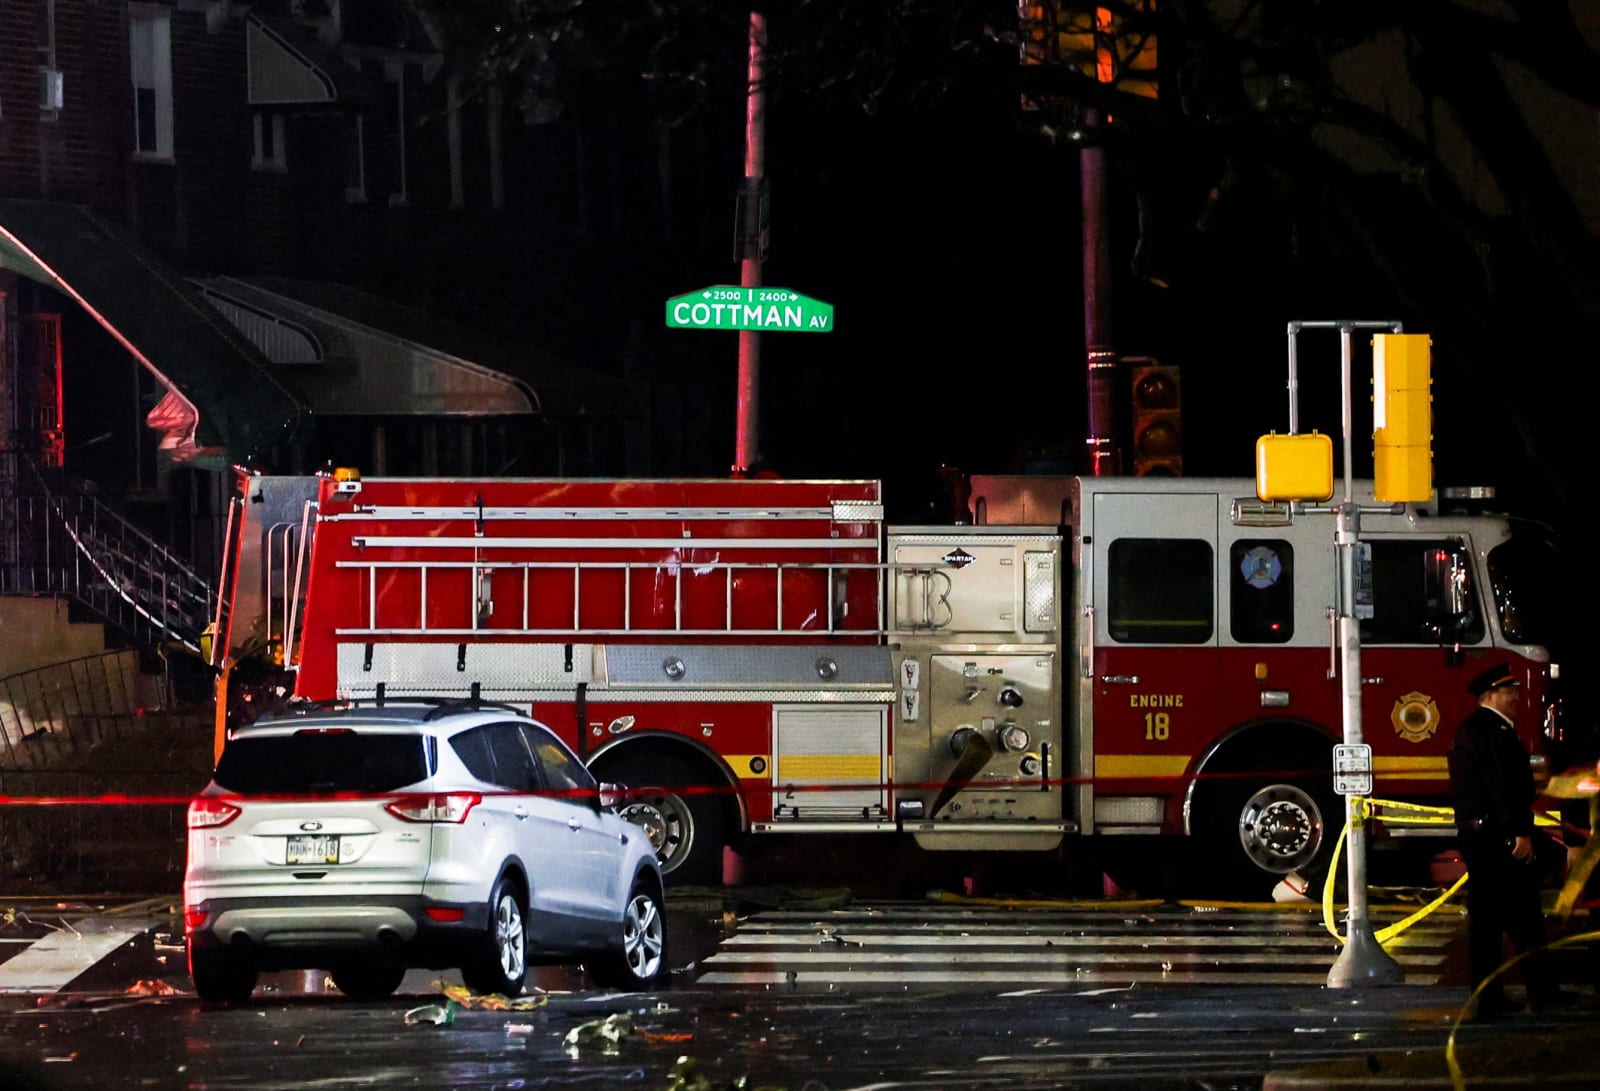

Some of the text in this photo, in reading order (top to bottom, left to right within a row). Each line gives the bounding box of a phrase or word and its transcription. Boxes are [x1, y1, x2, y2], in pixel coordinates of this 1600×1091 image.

[714, 291, 788, 301] 2500 2400
[674, 303, 828, 328] COTTMAN AV
[1130, 694, 1184, 707] ENGINE
[1144, 712, 1169, 740] 18
